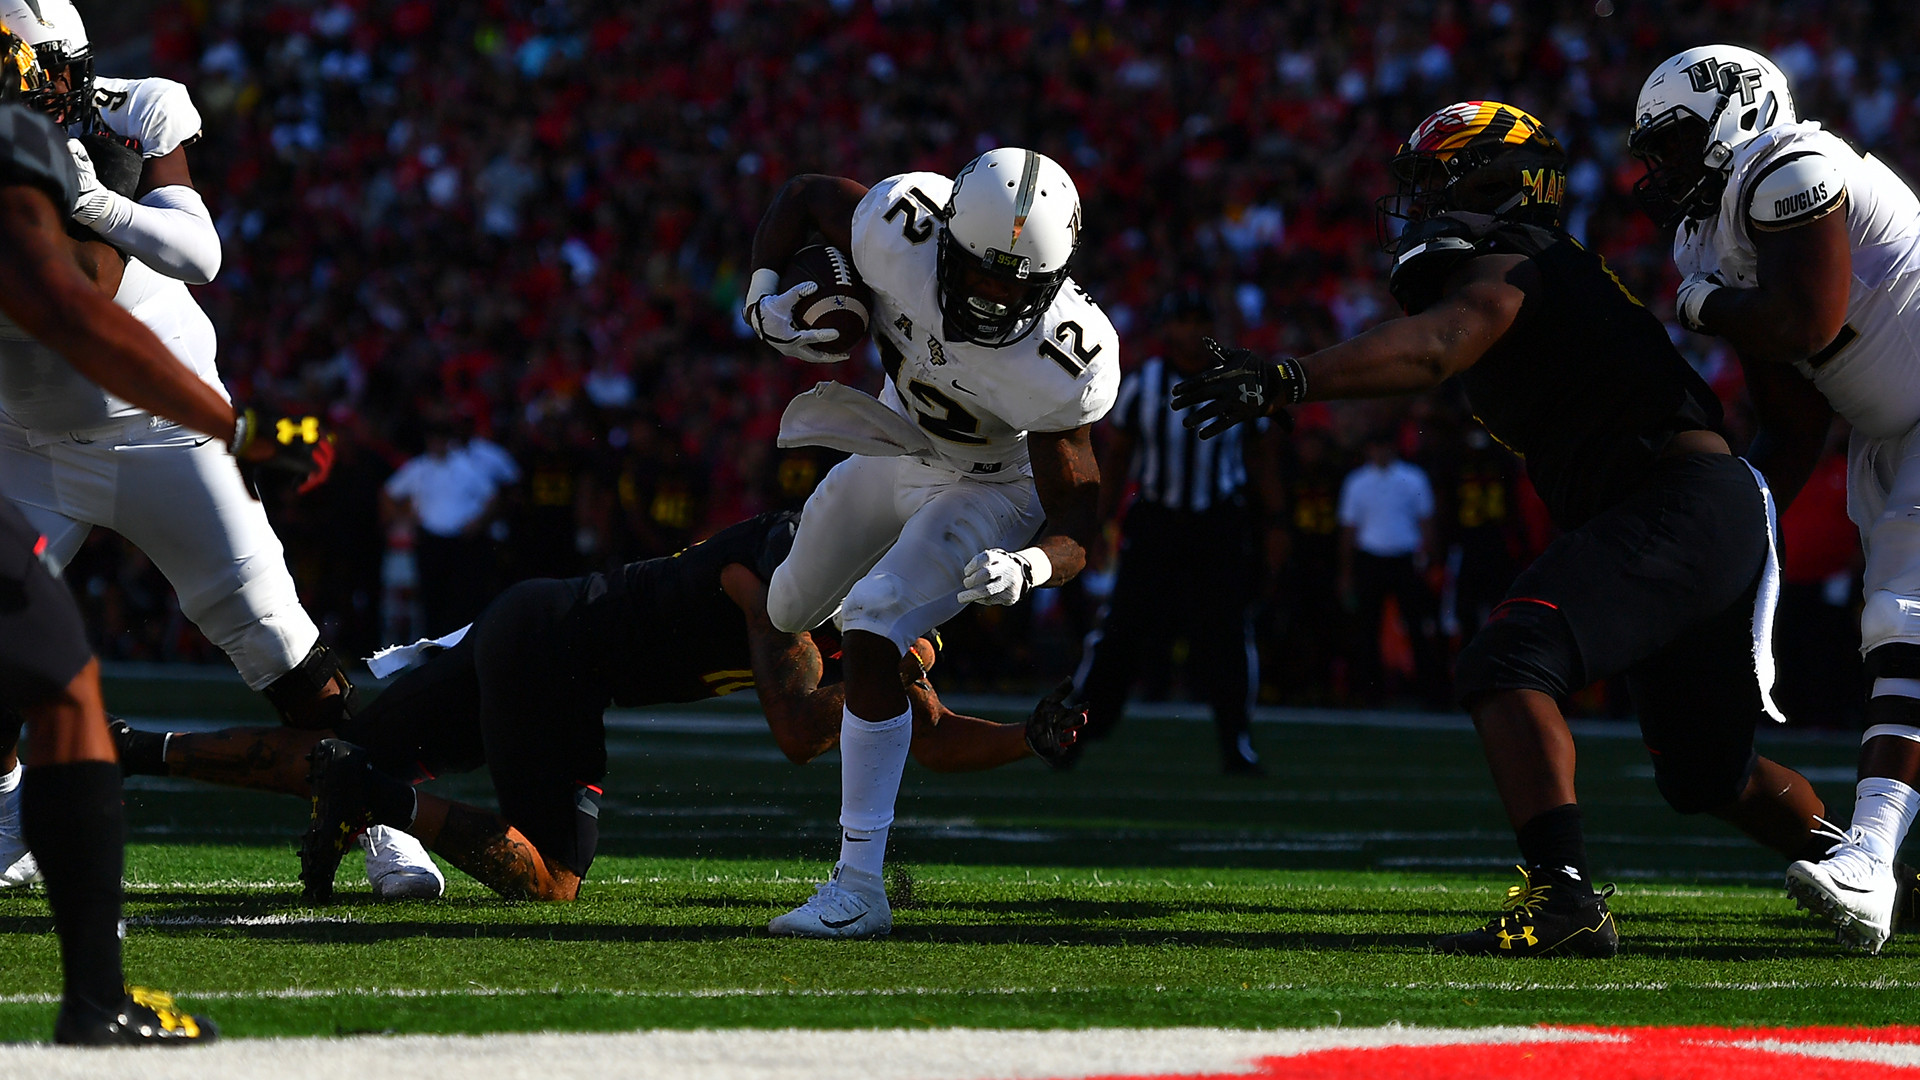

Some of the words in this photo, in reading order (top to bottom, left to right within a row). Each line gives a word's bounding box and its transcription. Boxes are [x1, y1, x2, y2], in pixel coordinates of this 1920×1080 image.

[1680, 57, 1762, 106] UCF
[883, 186, 948, 246] 12
[1774, 183, 1829, 218] DOUGLAS
[997, 253, 1018, 267] 954
[1037, 320, 1103, 381] 12
